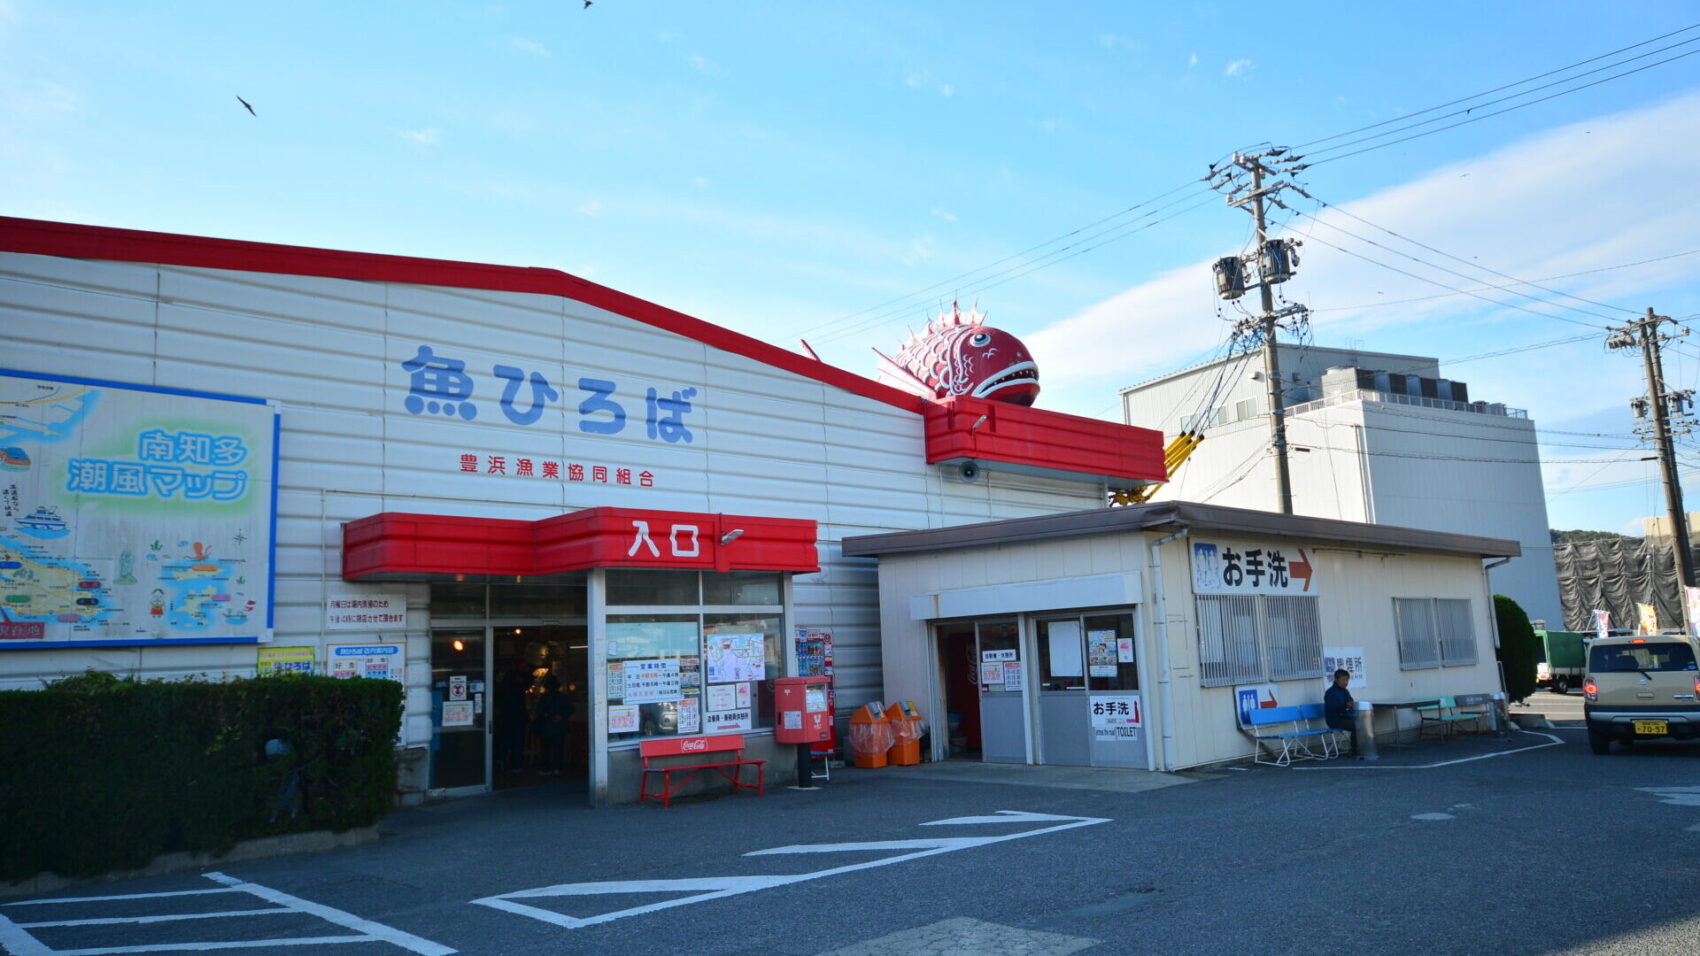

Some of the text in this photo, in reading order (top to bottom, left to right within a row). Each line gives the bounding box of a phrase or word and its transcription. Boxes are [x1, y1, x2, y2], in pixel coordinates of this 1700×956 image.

[401, 345, 697, 444] 魚ひろば
[139, 430, 247, 464] 南知多
[68, 460, 247, 500] 潮風マップ
[459, 454, 655, 488] 豊浜漁業協同組合
[628, 520, 700, 557] 入口
[1221, 547, 1289, 588] お手洗
[1093, 701, 1130, 716] お手洗
[1116, 727, 1136, 737] TOILET
